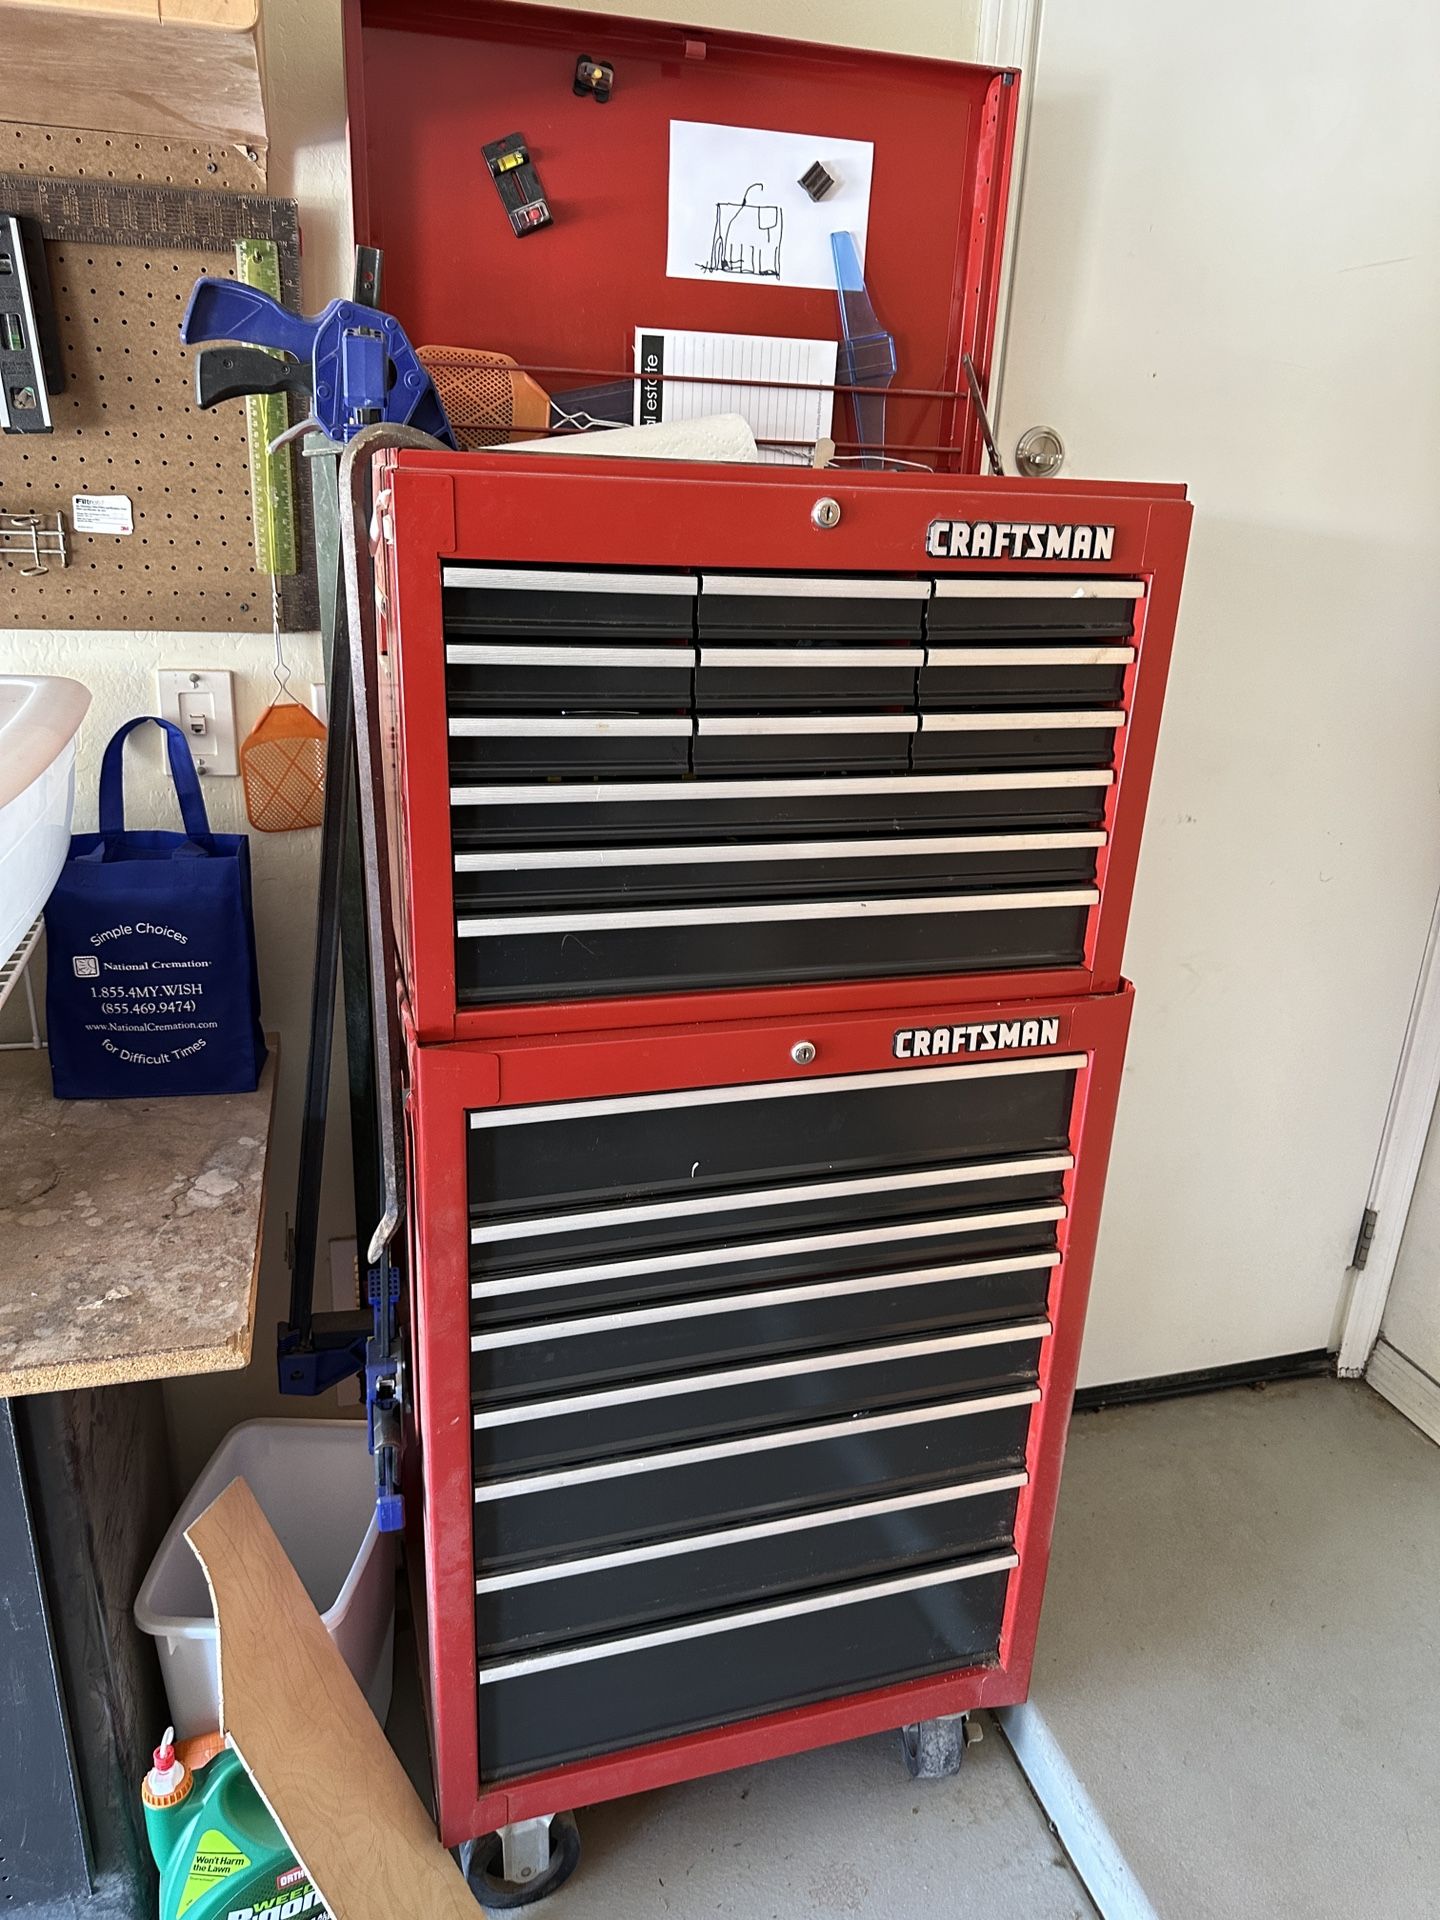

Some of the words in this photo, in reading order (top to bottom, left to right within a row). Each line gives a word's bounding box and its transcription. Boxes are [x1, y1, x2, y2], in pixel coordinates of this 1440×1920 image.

[928, 520, 1115, 560] CRAFTSMAN
[90, 924, 133, 947] Simple
[135, 922, 189, 945] Choices
[103, 961, 149, 972] National
[91, 983, 203, 999] 1.855.4MY.WISH
[101, 1000, 197, 1015] (855.469.9474)
[85, 1020, 218, 1032] www.NationalCremation.com
[894, 1017, 1059, 1059] CRAFTSMAN
[101, 1038, 119, 1054] for
[120, 1049, 171, 1065] Difficult
[171, 1038, 207, 1060] Times
[196, 1855, 219, 1865] Won't
[219, 1857, 245, 1866] Harm
[193, 1864, 207, 1872] the
[207, 1864, 231, 1873] Lawn
